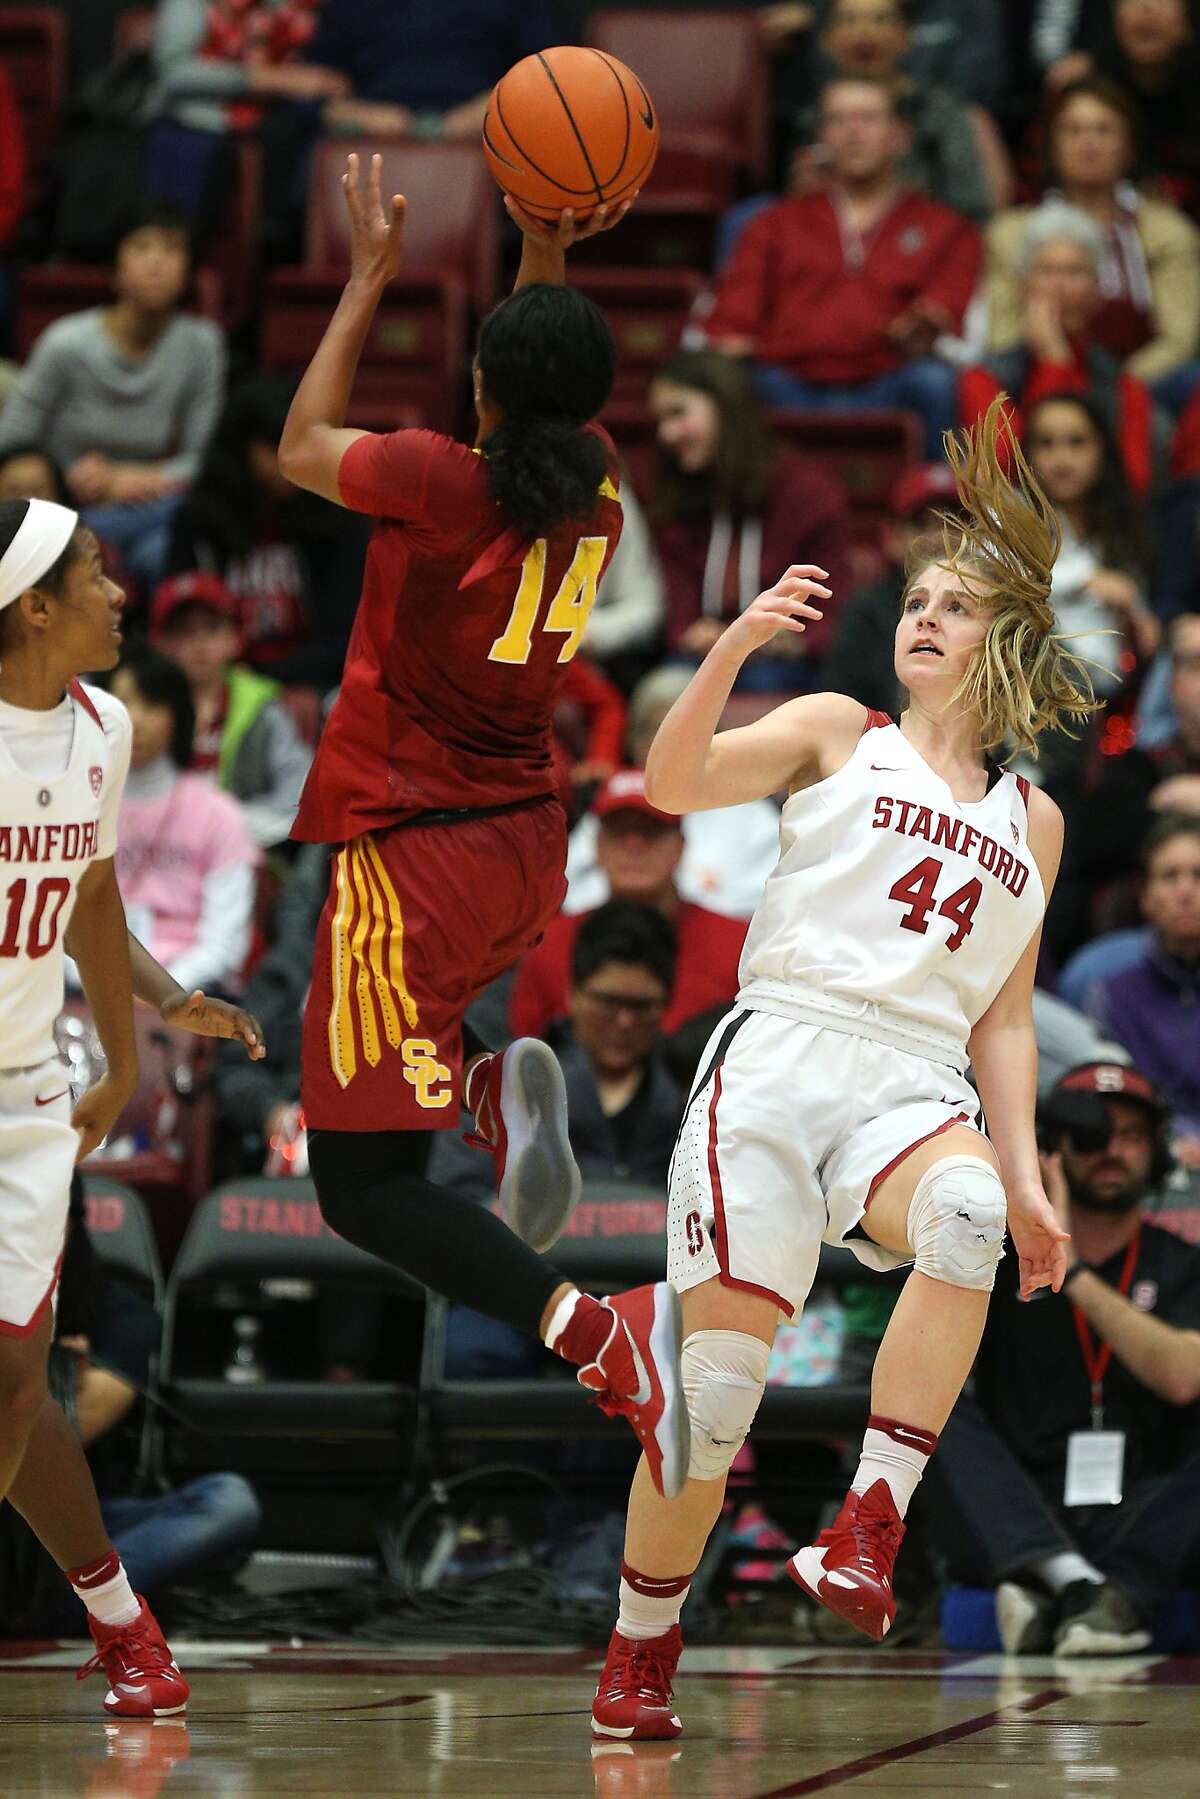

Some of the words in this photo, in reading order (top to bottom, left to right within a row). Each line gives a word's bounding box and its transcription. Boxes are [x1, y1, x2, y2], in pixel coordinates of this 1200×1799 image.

[487, 536, 608, 664] 14
[872, 796, 1030, 898] STANFORD
[0, 877, 71, 960] 10
[888, 856, 983, 953] 44
[401, 1038, 452, 1108] SC
